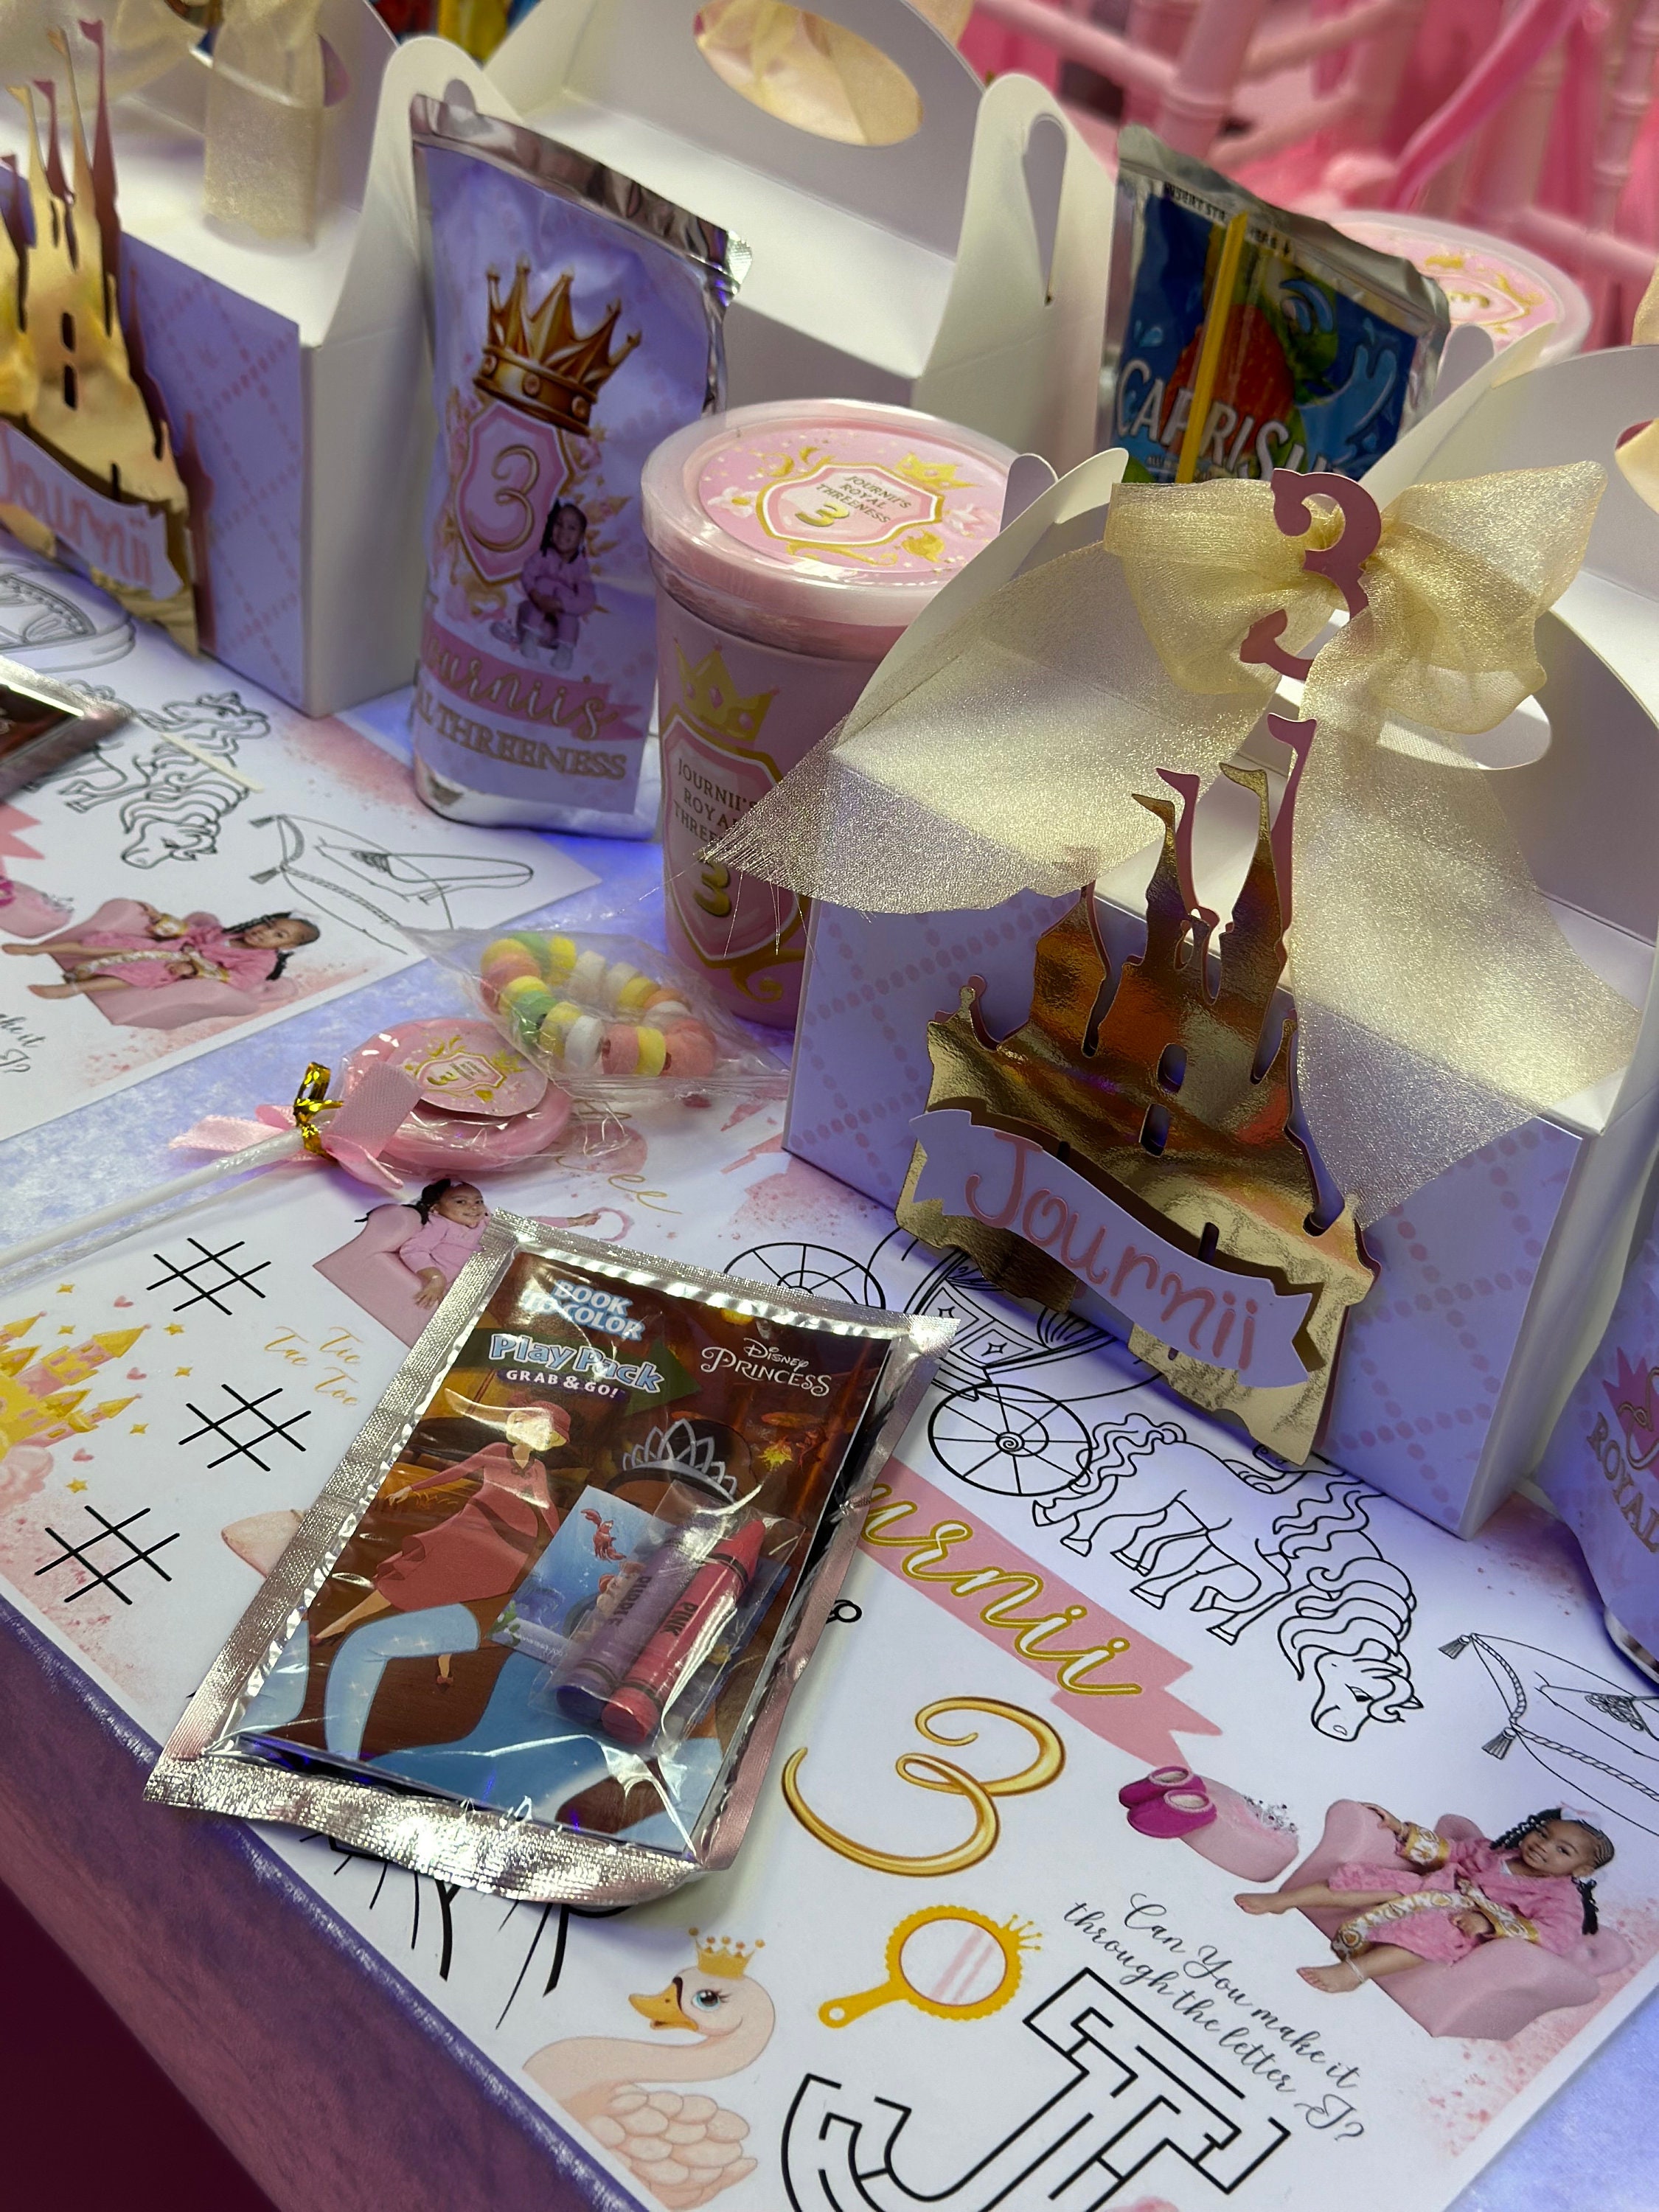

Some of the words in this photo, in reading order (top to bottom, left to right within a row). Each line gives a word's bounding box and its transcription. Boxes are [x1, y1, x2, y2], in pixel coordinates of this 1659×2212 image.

[466, 445, 540, 553] 3
[815, 484, 891, 524] THREENESS
[840, 484, 888, 509] ROYAL
[845, 476, 912, 509] JOURNII'S
[795, 501, 850, 528] 3
[684, 787, 737, 830] ROYA
[693, 855, 731, 917] 3
[964, 1130, 1255, 1371] Journii
[550, 1278, 634, 1318] BOOK
[563, 1301, 646, 1343] COLOR
[489, 1332, 577, 1371] Play
[572, 1344, 665, 1394] Pack
[506, 1369, 558, 1385] GRAB
[563, 1375, 580, 1391] &
[584, 1381, 619, 1399] GO!
[659, 1601, 700, 1637] PINK
[782, 1696, 1067, 1879] 3
[1064, 1902, 1180, 1995] through
[1172, 1990, 1220, 2032] the
[1218, 2027, 1296, 2093] letter
[1124, 1893, 1186, 1953] Can
[1183, 1945, 1253, 2006] You
[1251, 2008, 1326, 2062] make
[1326, 2062, 1360, 2088] it
